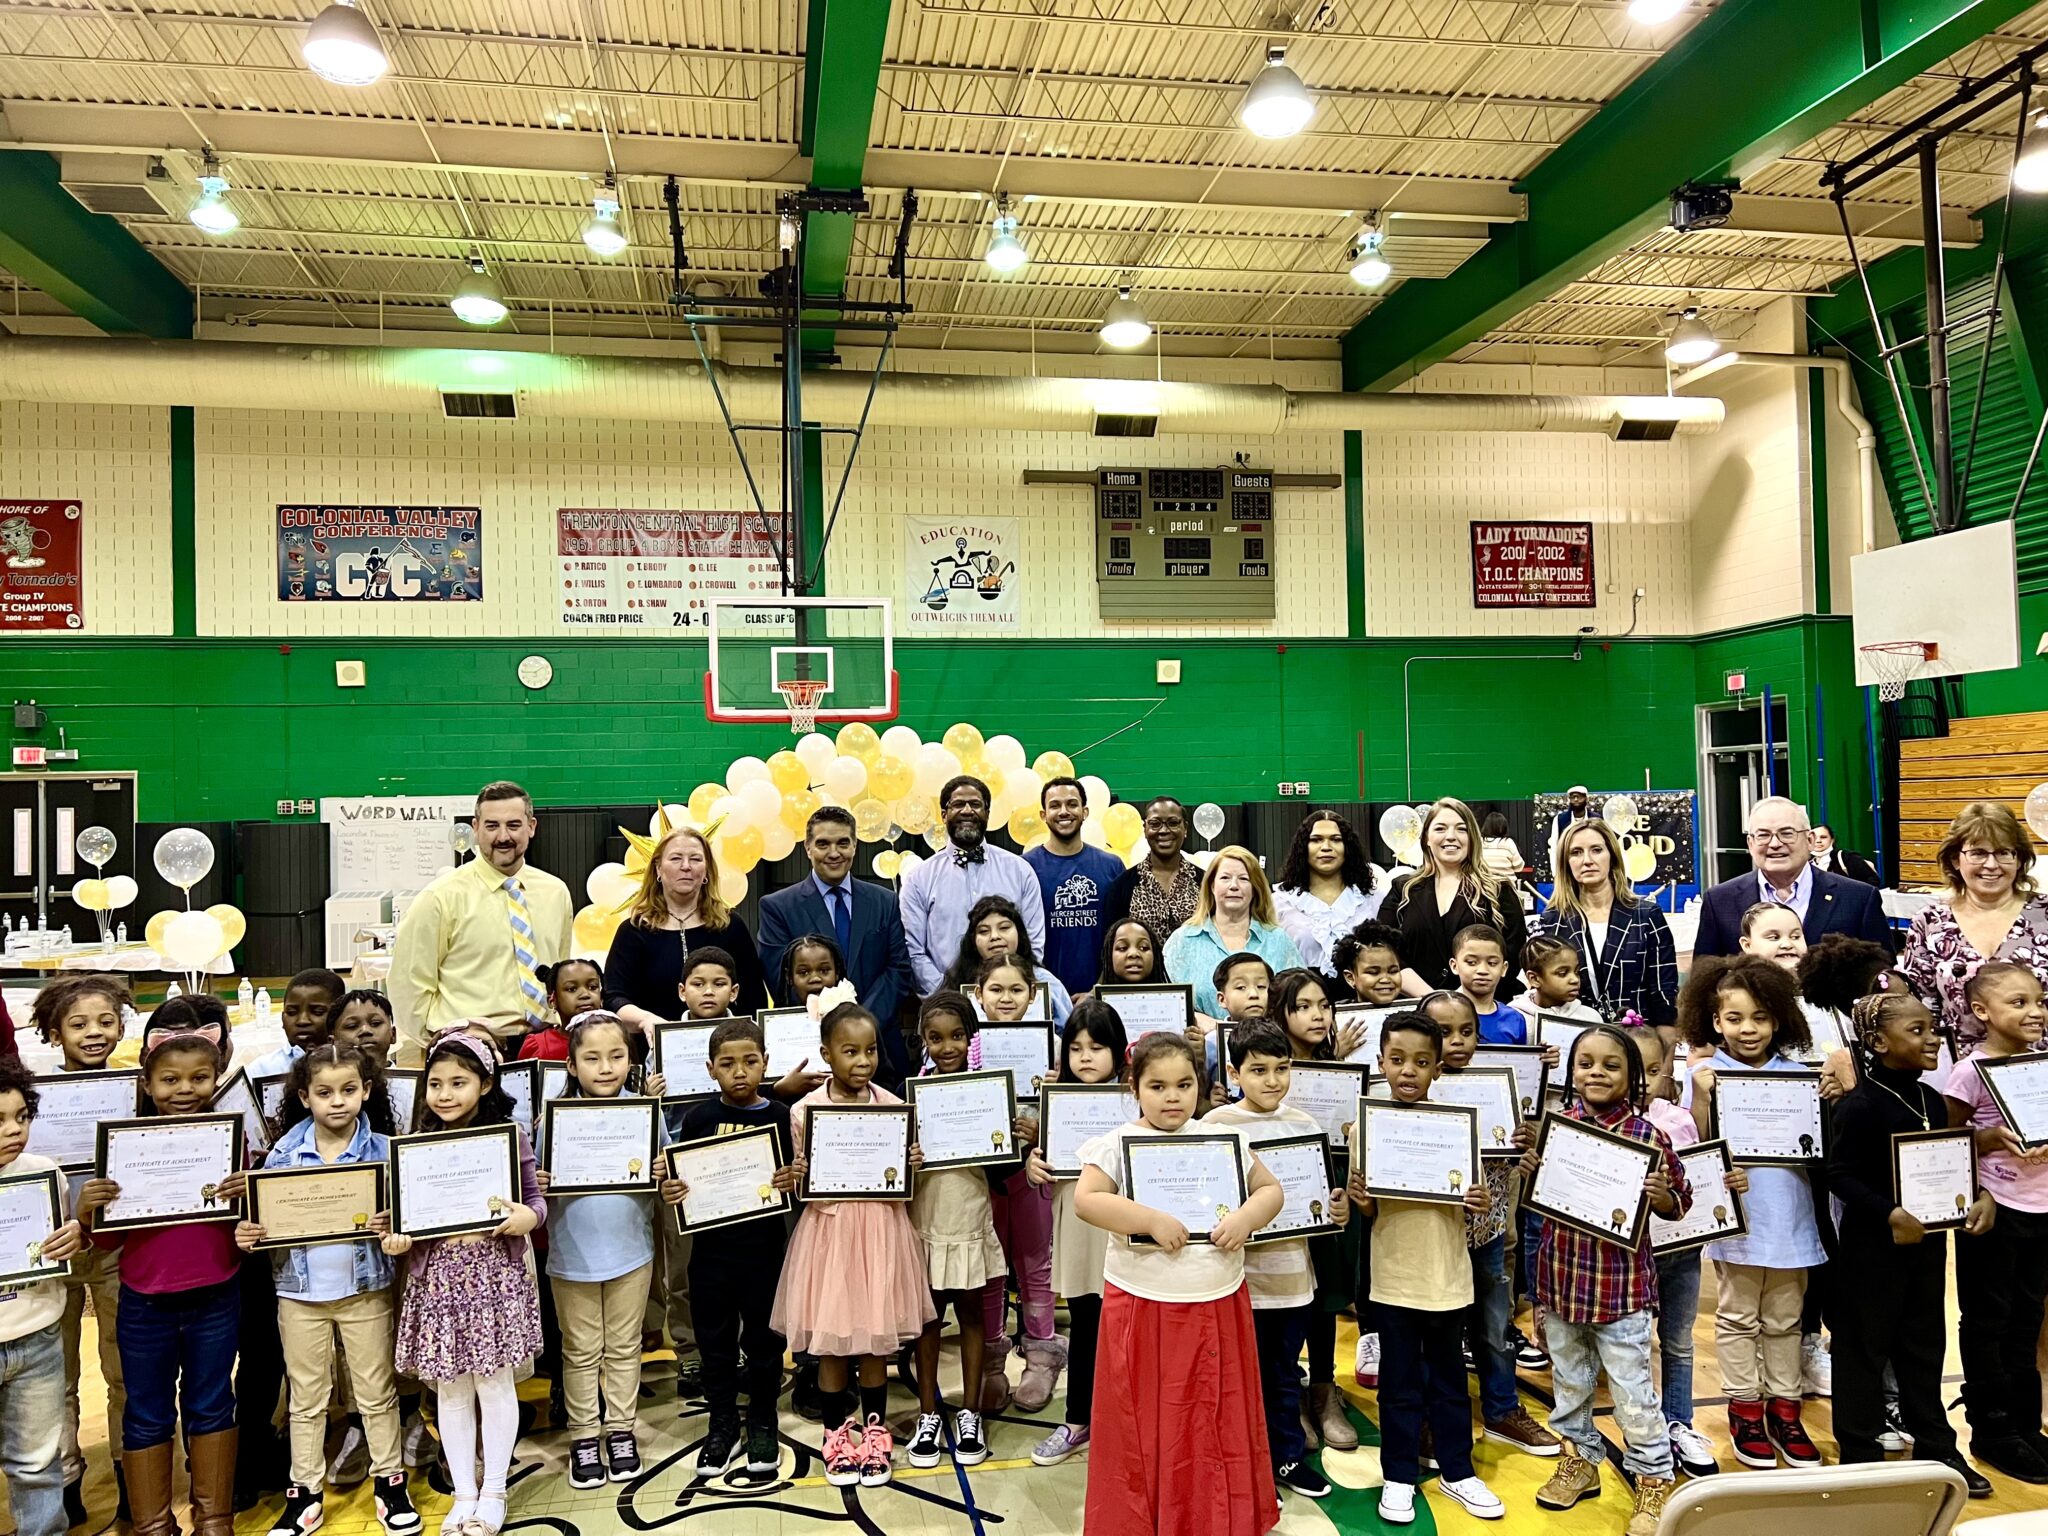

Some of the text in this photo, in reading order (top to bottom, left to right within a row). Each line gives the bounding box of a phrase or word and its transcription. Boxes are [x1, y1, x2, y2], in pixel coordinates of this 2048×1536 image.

[1107, 472, 1136, 485] Home
[1234, 474, 1270, 487] Guests
[33, 506, 49, 514] OF
[1160, 502, 1211, 511] 1 2 3 4
[280, 508, 478, 529] COLONIAL VALLEY
[561, 514, 630, 531] TRENTON
[635, 515, 701, 532] CENTRAL
[706, 515, 740, 533] HIGH
[313, 524, 448, 539] CONFERENCE
[1170, 519, 1204, 533] period
[920, 526, 1004, 545] EDUCATION
[1476, 526, 1588, 545] LADY TORNADOES
[598, 539, 636, 552] GROUP
[641, 540, 648, 551] 4
[652, 539, 684, 552] BOYS
[688, 540, 725, 553] STATE
[1500, 546, 1526, 560] 2001
[1537, 546, 1566, 560] 2002
[581, 562, 607, 571] RATICO
[707, 564, 717, 572] LEE
[1108, 563, 1133, 575] fouls
[1171, 563, 1204, 577] player
[1242, 564, 1266, 576] fouls
[8, 572, 77, 586] Tornado's
[1483, 567, 1583, 581] T.O.C. CHAMPIONS
[582, 580, 605, 588] WILLIS
[644, 580, 682, 589] LOMBARDO
[705, 581, 736, 589] CROWELL
[3, 592, 44, 601] Group IV
[1478, 593, 1590, 602] COLONIAL VALLEY CONFERENCE
[11, 603, 73, 612] CHAMPIONS
[646, 599, 667, 607] SHAW
[563, 613, 643, 623] COACH FRED PRICE
[672, 611, 691, 627] 24
[745, 614, 773, 623] CLASS
[775, 614, 785, 623] OF
[911, 612, 1015, 622] OUTWEIGHS THEM ALL
[340, 804, 396, 820] WORD
[400, 806, 447, 821] WALL
[1075, 909, 1097, 917] STREET
[1050, 917, 1098, 928] FRIENDS
[124, 1161, 160, 1169] CERTIFICATE
[170, 1156, 212, 1166] ACHIEVEMENT
[416, 1173, 448, 1182] CERTIFICATE
[457, 1167, 493, 1177] ACHIEVEMENT
